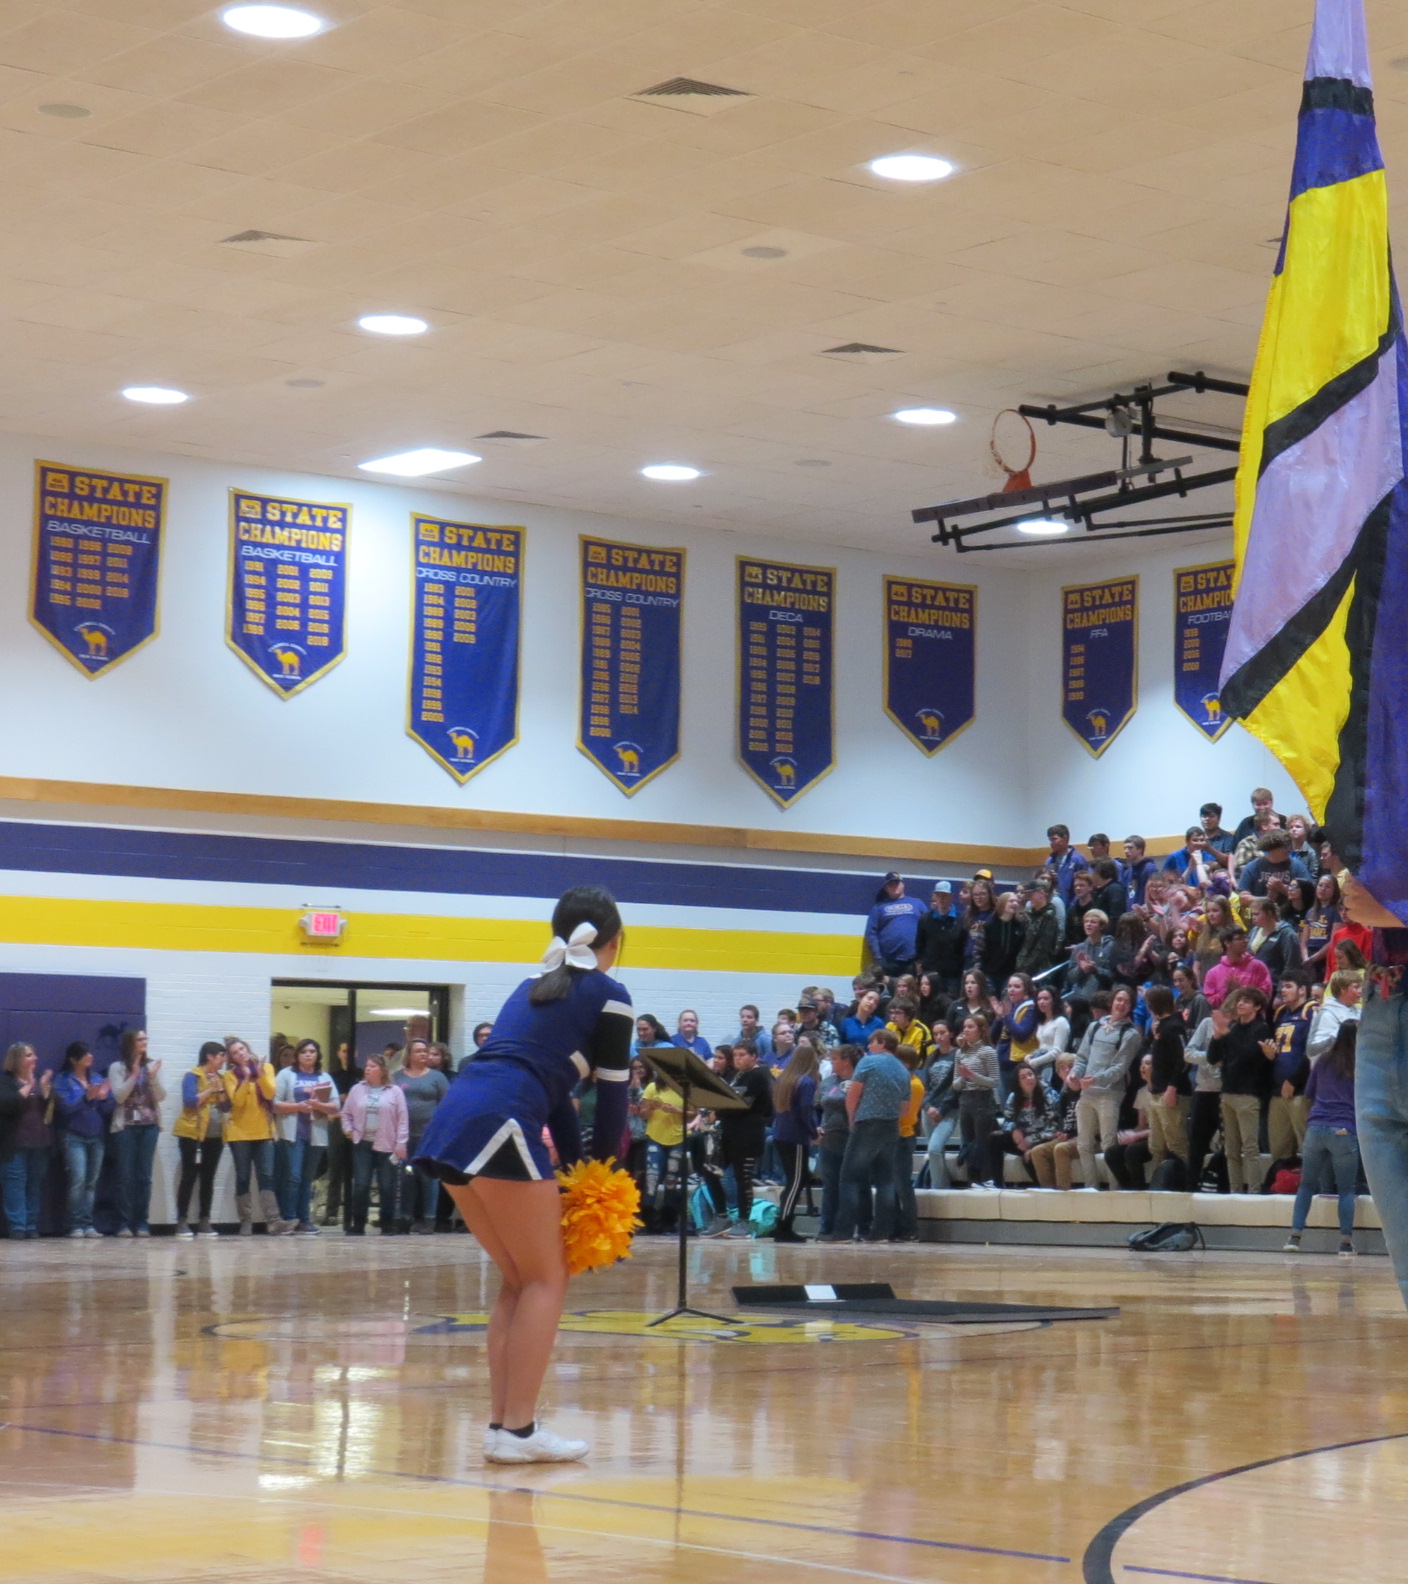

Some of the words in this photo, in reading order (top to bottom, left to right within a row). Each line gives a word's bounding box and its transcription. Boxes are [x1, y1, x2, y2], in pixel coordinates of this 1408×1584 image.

[75, 477, 157, 505] STATE
[46, 497, 156, 528] CHAMPIONS
[267, 503, 342, 529] STATE
[48, 521, 151, 544] BASKETBALL
[240, 522, 342, 552] CHAMPIONS
[445, 527, 516, 551] STATE
[242, 546, 338, 566] BASKETBALL
[420, 546, 516, 574] CHAMPIONS
[612, 550, 677, 572] STATE
[417, 568, 457, 582] CROSS
[460, 574, 518, 588] COUNTRY
[588, 568, 676, 594] CHAMPIONS
[767, 569, 828, 592] STATE
[1198, 569, 1236, 590] STAT
[585, 588, 622, 601] CROSS
[626, 594, 680, 608] COUNTRY
[746, 587, 828, 612] CHAMPIONS
[913, 588, 970, 609] STATE
[1084, 585, 1132, 607] STATE
[1180, 590, 1235, 612] CHAMPIO
[769, 611, 803, 623] DECA
[891, 606, 970, 629] CHAMPIONS
[1067, 606, 1132, 629] CHAMPIONS
[908, 627, 953, 640] DRAMA
[1090, 629, 1108, 639] FFA
